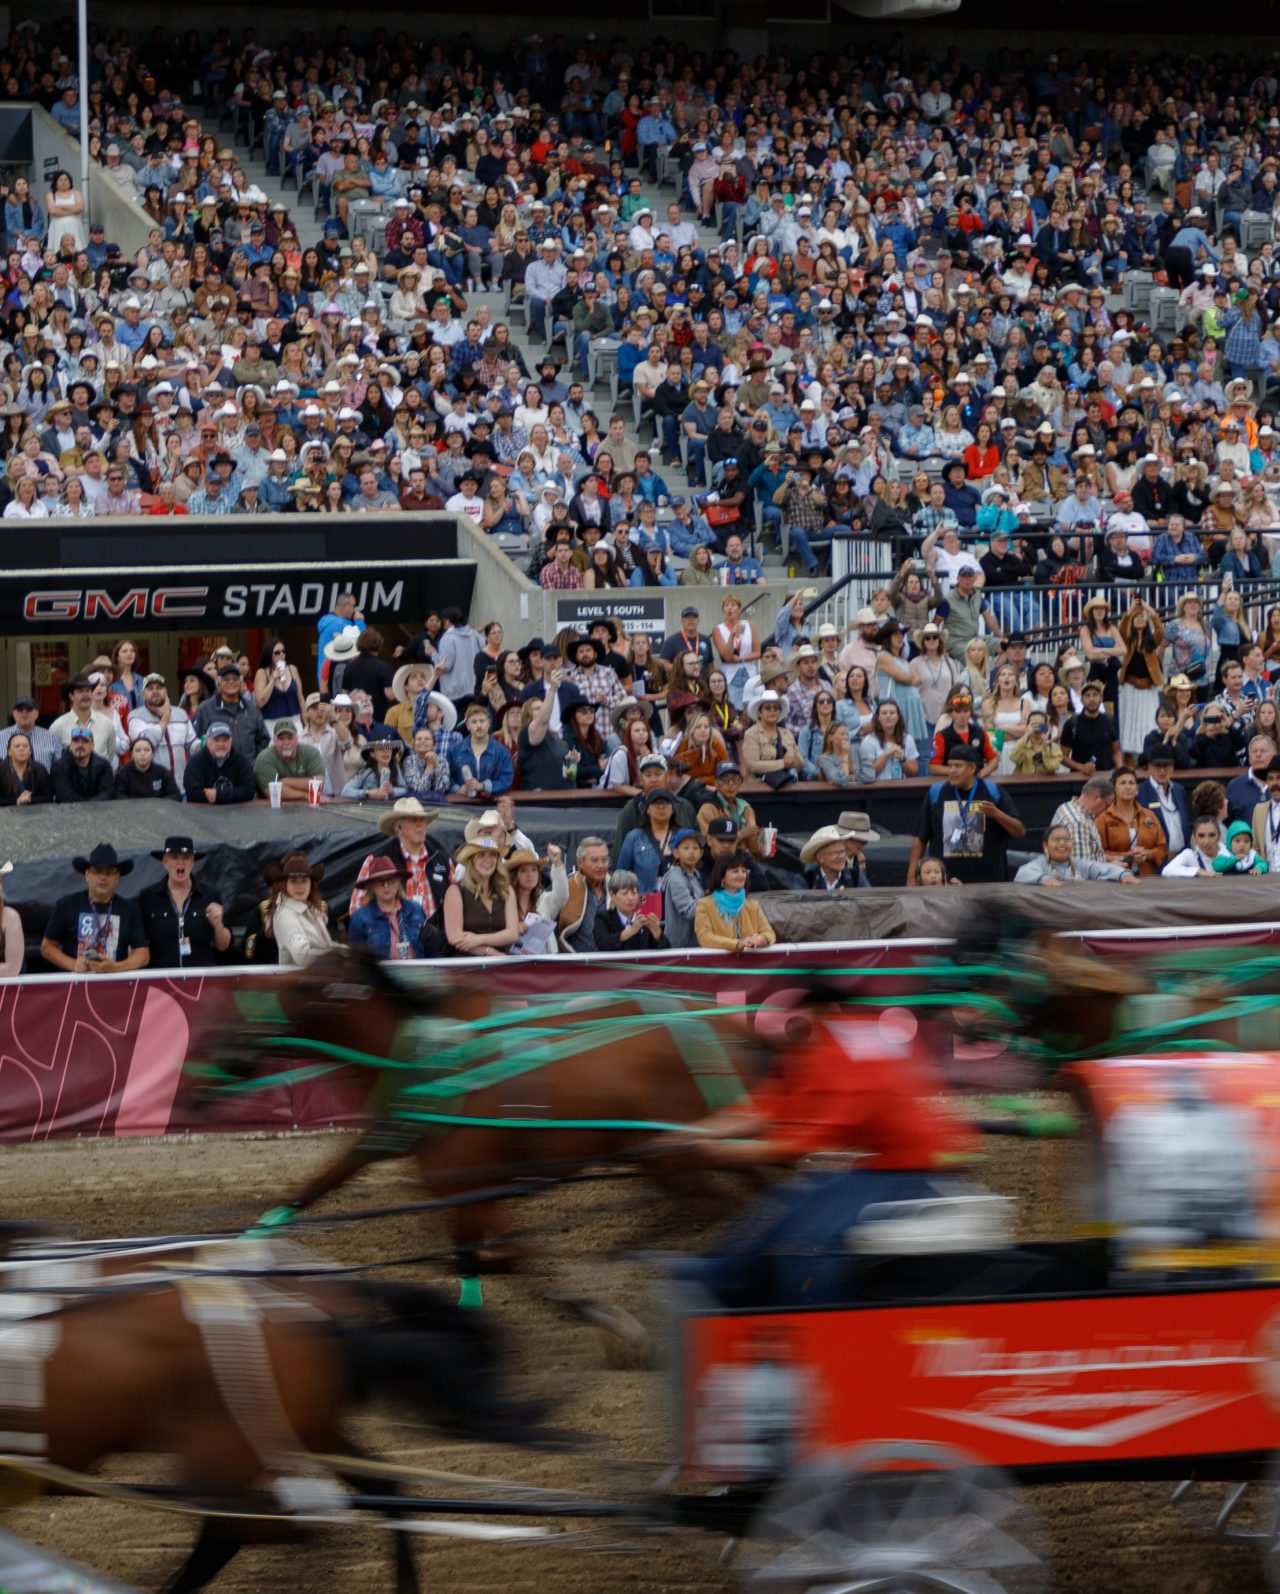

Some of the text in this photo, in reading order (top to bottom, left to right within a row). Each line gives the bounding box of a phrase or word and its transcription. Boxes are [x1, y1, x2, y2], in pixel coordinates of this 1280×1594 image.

[23, 580, 404, 620] GMC STADIUM
[577, 605, 645, 616] LEVEL 1 SOUTH
